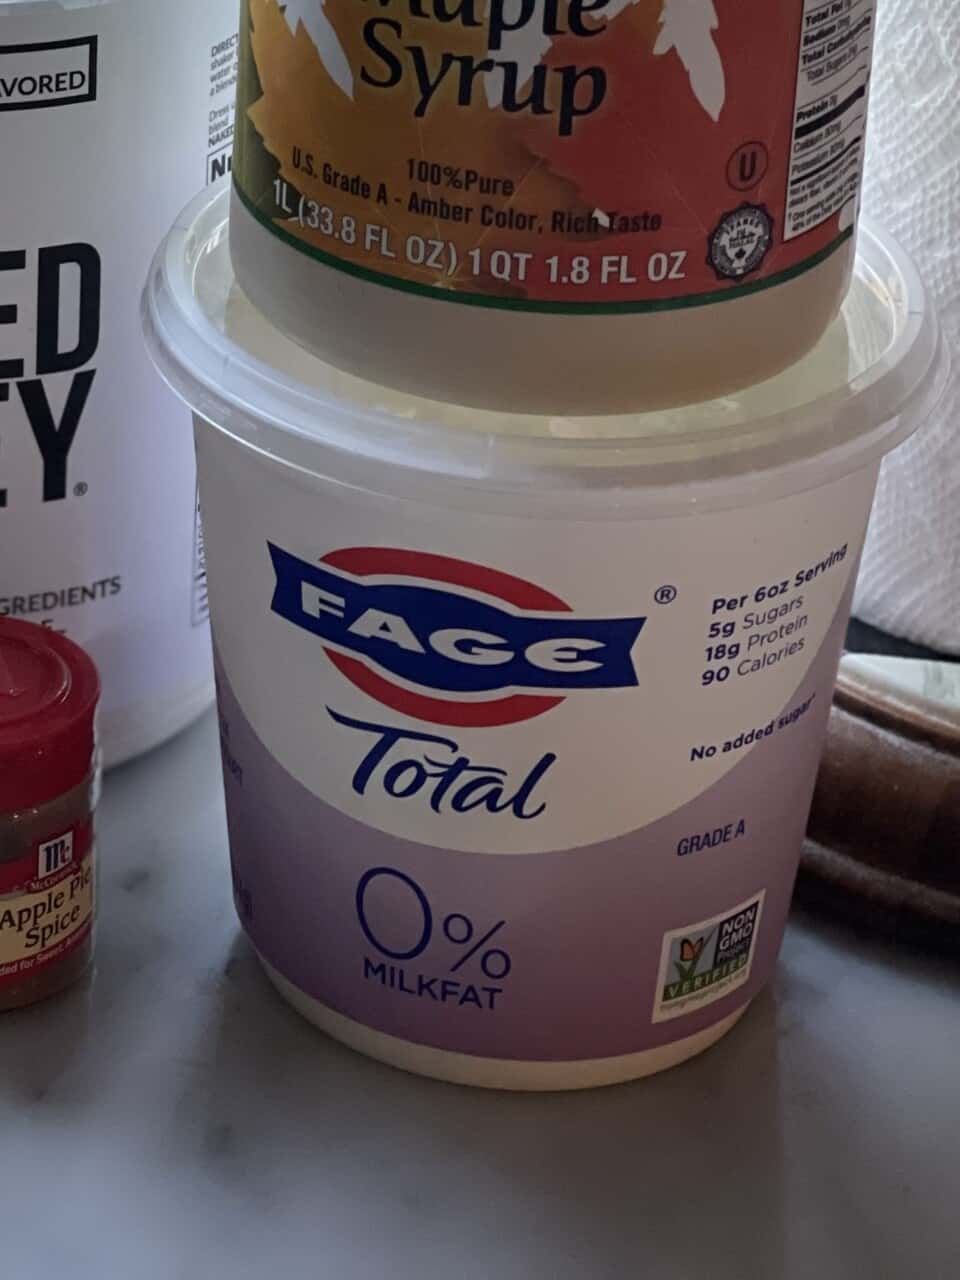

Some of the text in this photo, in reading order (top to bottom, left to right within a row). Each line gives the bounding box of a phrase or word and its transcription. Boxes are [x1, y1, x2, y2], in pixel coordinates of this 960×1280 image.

[359, 17, 609, 136] Syrup
[291, 145, 319, 183] U.S.
[322, 160, 372, 202] Grade
[376, 182, 389, 206] A
[407, 190, 474, 223] Amber
[479, 205, 544, 236] Color,
[607, 210, 663, 234] Taste
[273, 178, 688, 284] 1L (33.8 FL OZ) 1 QT 1.8 FL OZ
[711, 543, 849, 615] Per 6oz Serving
[300, 580, 605, 673] FAGE
[704, 613, 809, 662] 18g Protein
[707, 594, 805, 639] 5g Sugars
[700, 636, 806, 687] 90 Calories
[324, 704, 558, 820] Total
[689, 744, 718, 763] No
[721, 720, 775, 754] added
[676, 818, 746, 858] GRADE A
[23, 903, 81, 950] Spice
[355, 865, 513, 982] 0%
[719, 922, 753, 951] GMO
[722, 907, 756, 935] NON
[19, 956, 35, 970] for
[363, 957, 505, 1011] MILKFAT
[667, 952, 749, 999] VERIFIED
